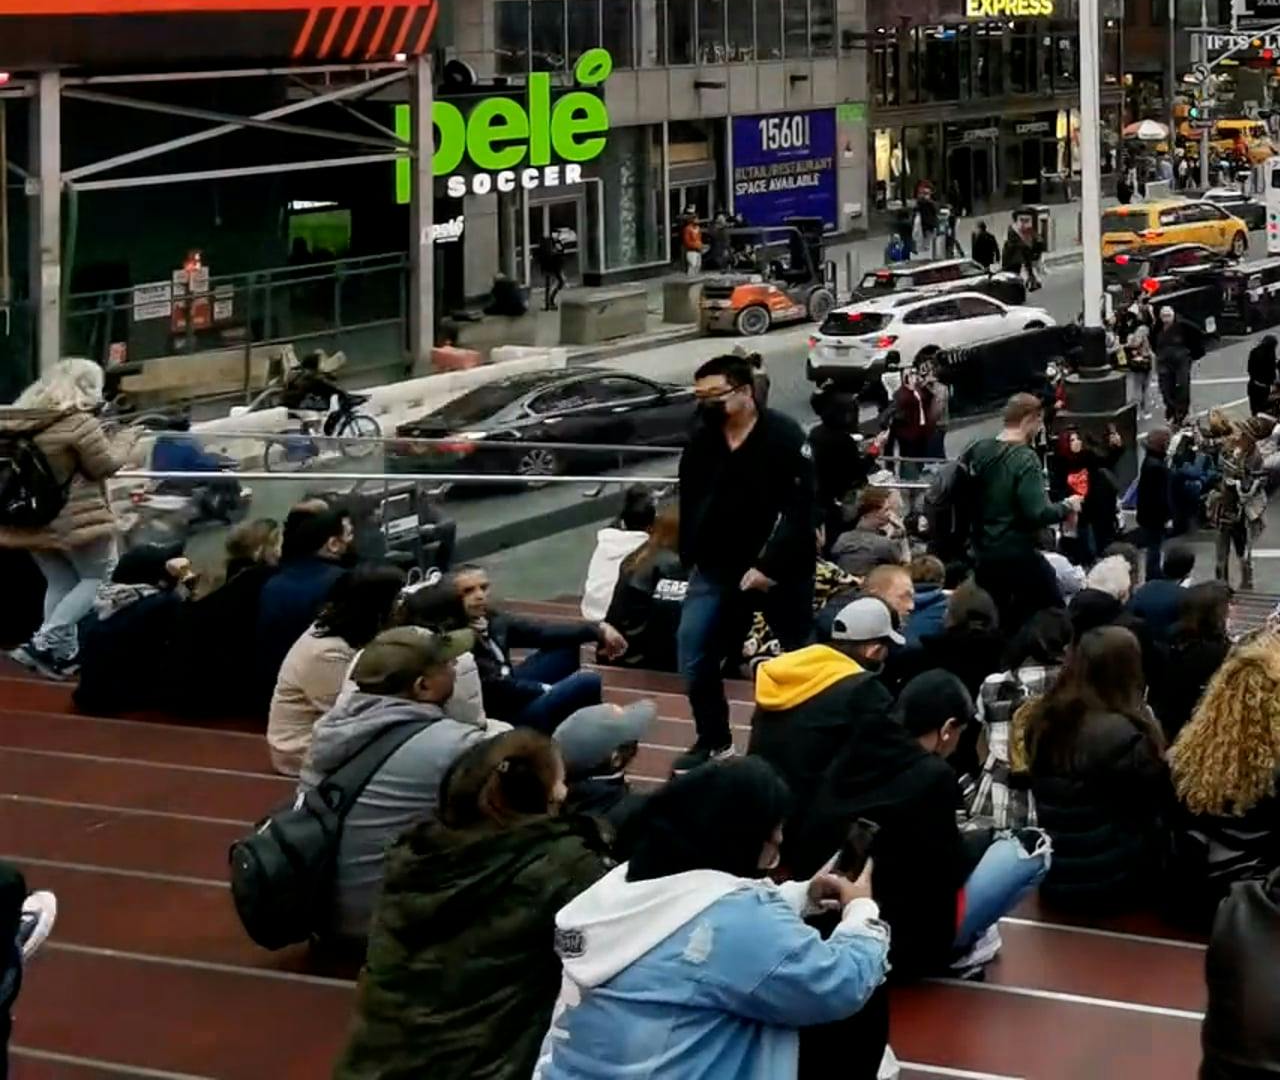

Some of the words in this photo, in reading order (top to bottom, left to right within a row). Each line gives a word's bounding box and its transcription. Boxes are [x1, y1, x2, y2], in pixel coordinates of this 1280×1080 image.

[1207, 35, 1250, 51] IFTS
[395, 47, 612, 204] pelé
[447, 163, 583, 198] SOCCER
[735, 180, 767, 196] SPACE
[768, 173, 821, 192] AVAILABLE
